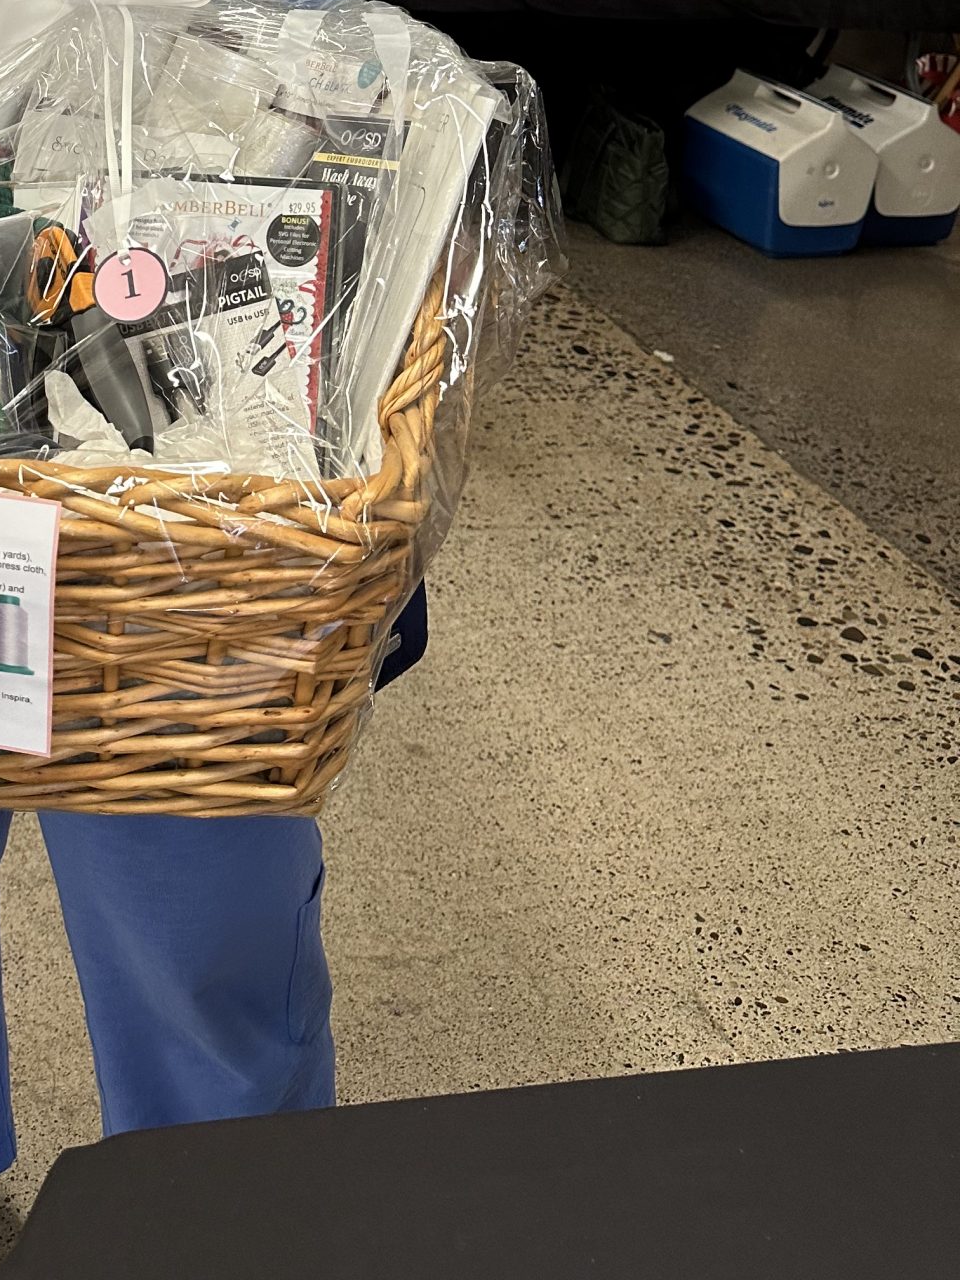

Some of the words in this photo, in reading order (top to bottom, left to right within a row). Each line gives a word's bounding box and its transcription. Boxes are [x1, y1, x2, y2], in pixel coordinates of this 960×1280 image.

[726, 102, 777, 133] Playmate
[326, 155, 346, 163] EXPERT
[321, 167, 350, 183] Wash
[289, 202, 316, 214] $29.95
[281, 216, 309, 225] BONUS!
[283, 247, 303, 255] Cutting
[121, 269, 142, 299] 1
[218, 286, 267, 308] PIGTAIL
[227, 316, 244, 326] USB
[245, 312, 253, 321] to
[7, 585, 24, 593] and
